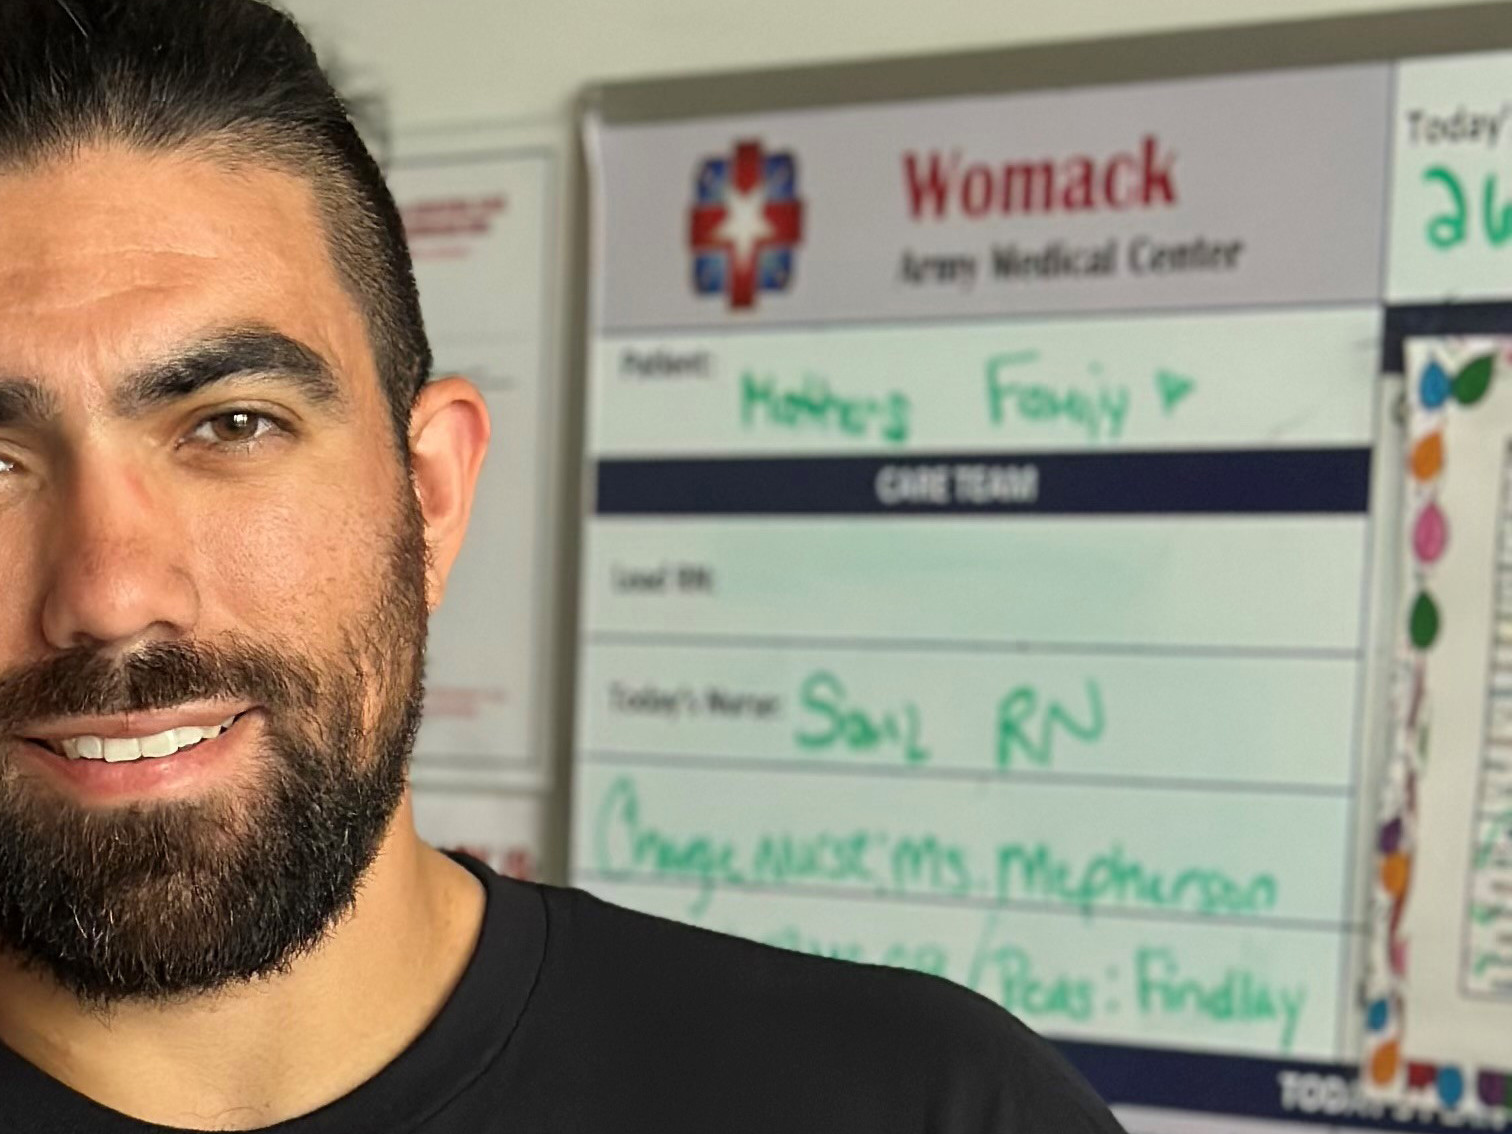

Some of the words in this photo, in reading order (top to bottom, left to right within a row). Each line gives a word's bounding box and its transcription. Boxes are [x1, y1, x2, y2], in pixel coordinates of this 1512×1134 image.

[1404, 103, 1512, 148] Today'
[900, 134, 1180, 222] Womack
[900, 247, 977, 292] Army
[992, 236, 1118, 282] Medical
[1128, 234, 1244, 278] Center
[874, 464, 950, 505] CARE
[953, 464, 1041, 504] TEAM
[996, 675, 1107, 772] RN
